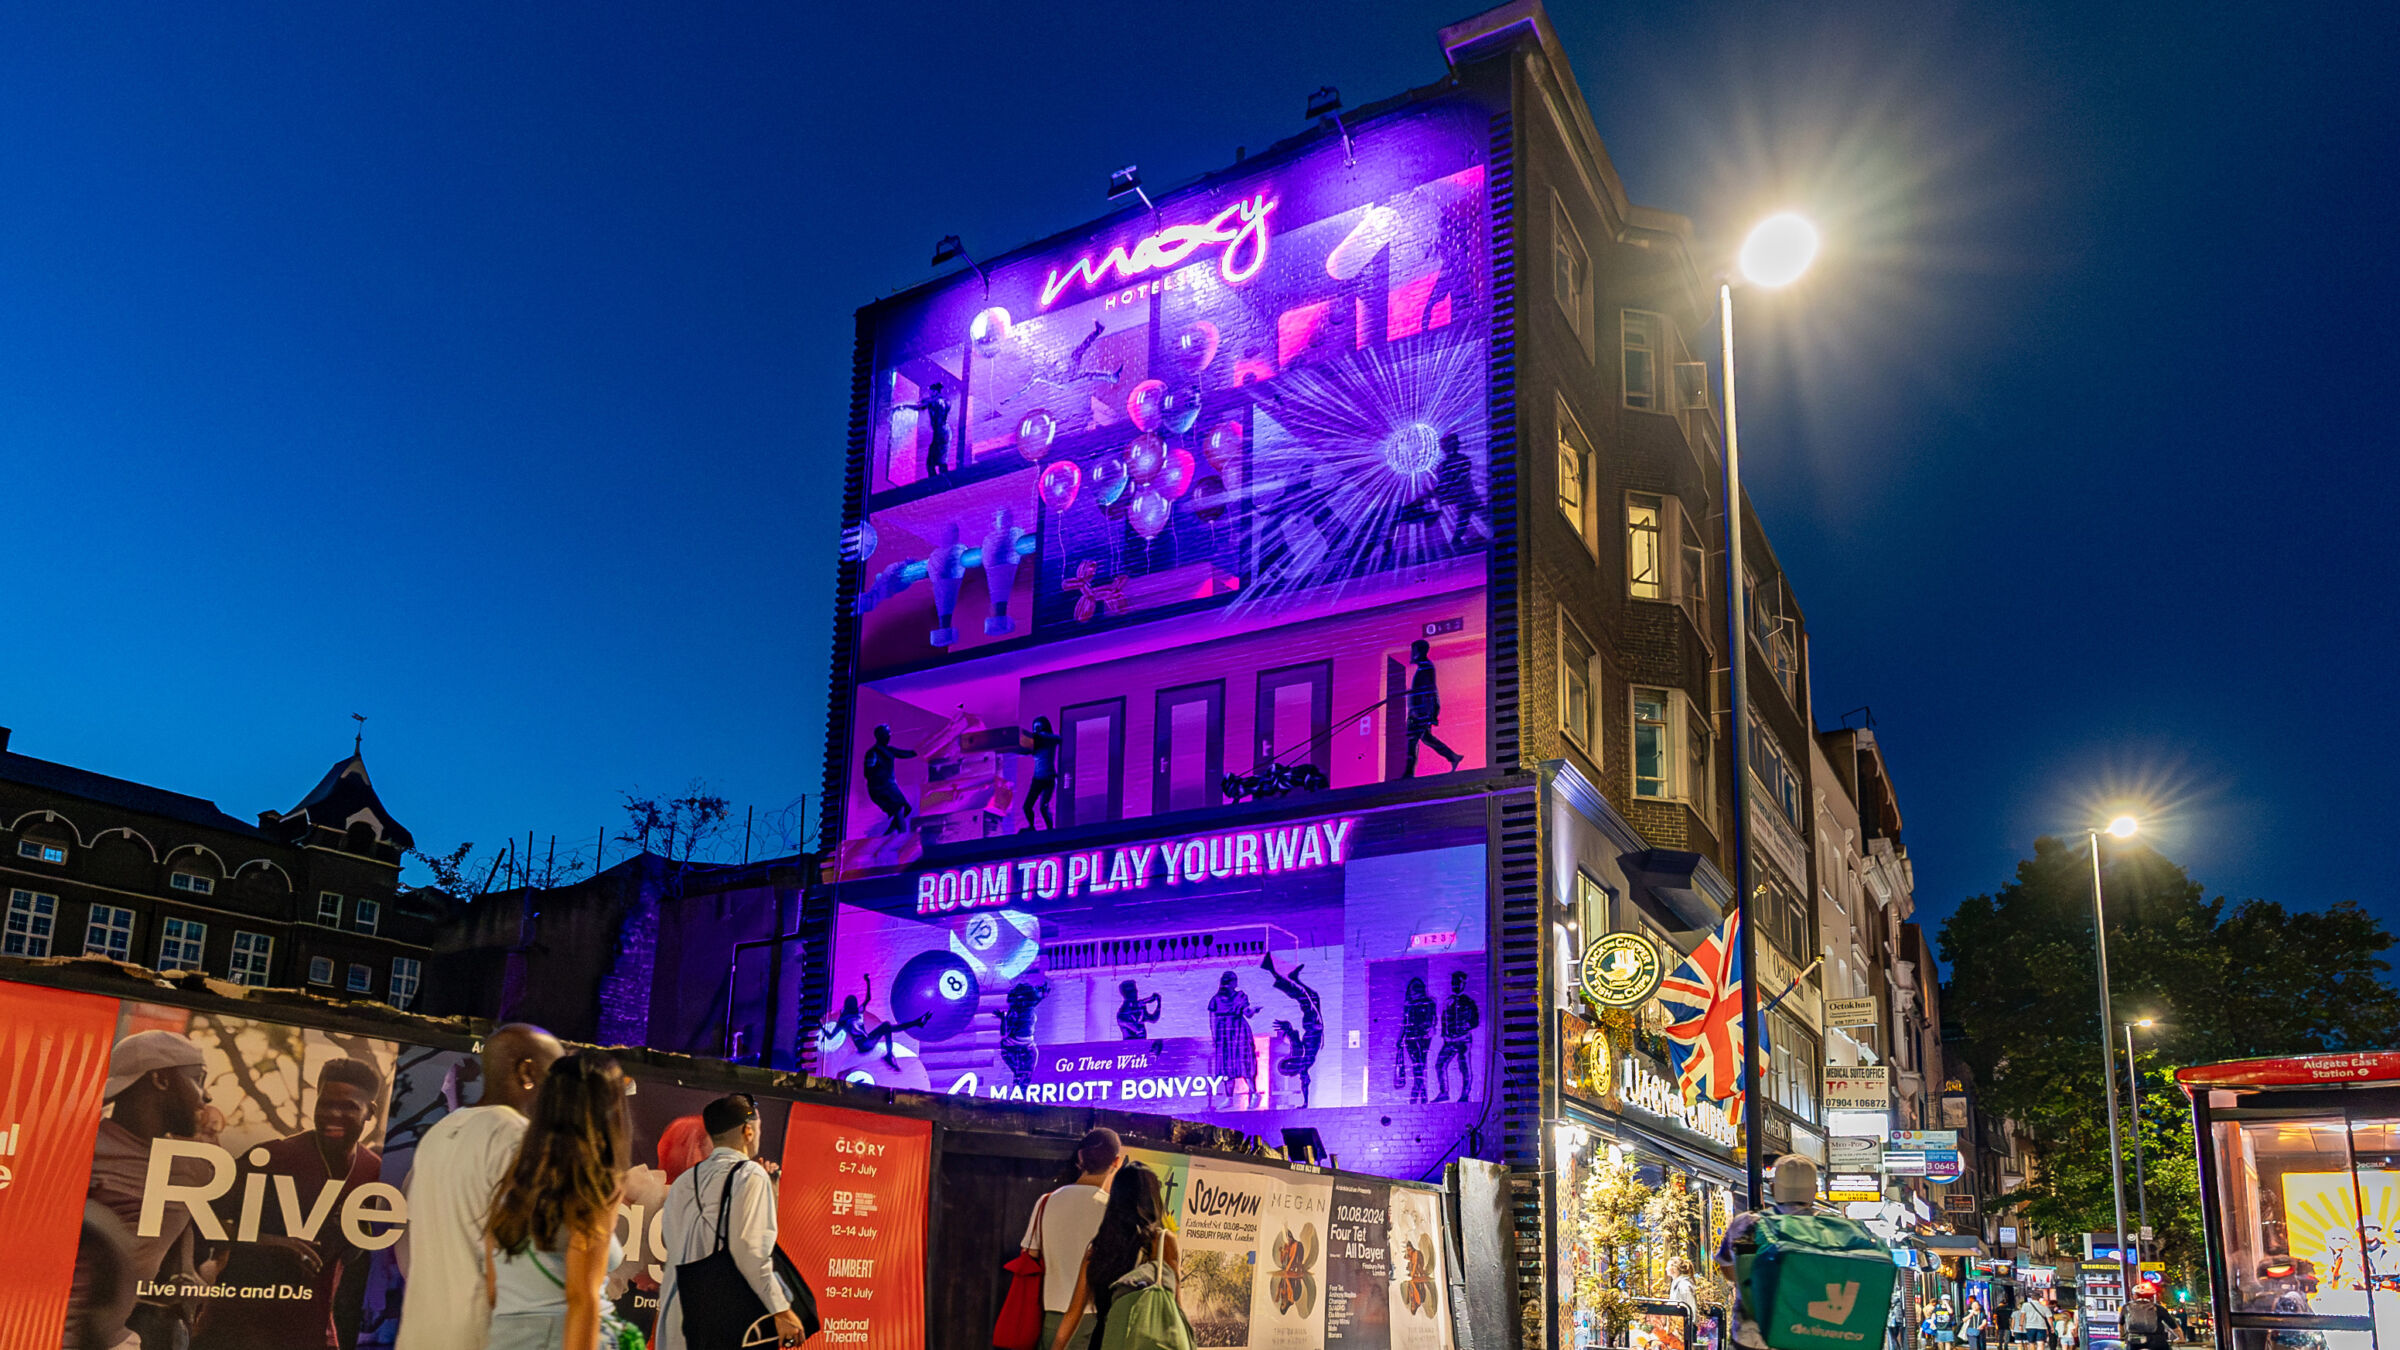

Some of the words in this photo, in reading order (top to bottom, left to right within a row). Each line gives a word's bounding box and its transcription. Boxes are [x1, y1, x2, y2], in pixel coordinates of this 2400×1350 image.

[1040, 194, 1276, 306] moxy
[1105, 272, 1187, 311] HOTELS
[916, 865, 1008, 914] ROOM
[1018, 858, 1058, 901] TO
[1067, 847, 1151, 897] PLAY
[1160, 834, 1258, 885] YOUR
[1263, 820, 1350, 871] WAY
[970, 919, 992, 946] 12
[1590, 945, 1607, 968] JACK
[1615, 938, 1652, 963] CHIPPER
[947, 976, 962, 992] 8
[1590, 978, 1613, 998] FISH
[1624, 974, 1651, 998] CHIPS
[1829, 1001, 1872, 1010] Octokhan
[1055, 1058, 1074, 1073] Go
[1078, 1056, 1112, 1072] There
[1117, 1054, 1148, 1070] With
[1826, 1068, 1849, 1078] MEDICAL
[1850, 1068, 1865, 1078] SUITE
[1865, 1068, 1885, 1078] OFFICE
[2303, 1060, 2348, 1070] Aldgate
[2351, 1058, 2378, 1067] East
[2312, 1069, 2355, 1078] Station
[990, 1081, 1113, 1103] MARRIOTT
[1826, 1098, 1852, 1107] 07904
[1855, 1099, 1887, 1107] 106872
[835, 1136, 886, 1157] GLORY
[857, 1163, 878, 1178] July
[1188, 1179, 1261, 1217] SOLOMUN
[1271, 1193, 1326, 1213] MEGAN
[1337, 1205, 1385, 1224] 10.08.2024
[857, 1226, 878, 1240] July
[1186, 1229, 1217, 1240] FINSBURY
[1217, 1231, 1232, 1241] PARK
[1234, 1232, 1255, 1242] London
[1330, 1223, 1351, 1240] Four
[1353, 1225, 1367, 1242] Tet
[1345, 1242, 1357, 1259] All
[1358, 1243, 1385, 1262] Dayer
[828, 1258, 874, 1278] RAMBERT
[136, 1280, 176, 1296] Live
[180, 1282, 236, 1298] music
[240, 1284, 275, 1299] and
[278, 1284, 313, 1300] DJs
[853, 1287, 874, 1301] July
[824, 1317, 869, 1330] National
[824, 1330, 868, 1343] Theatre
